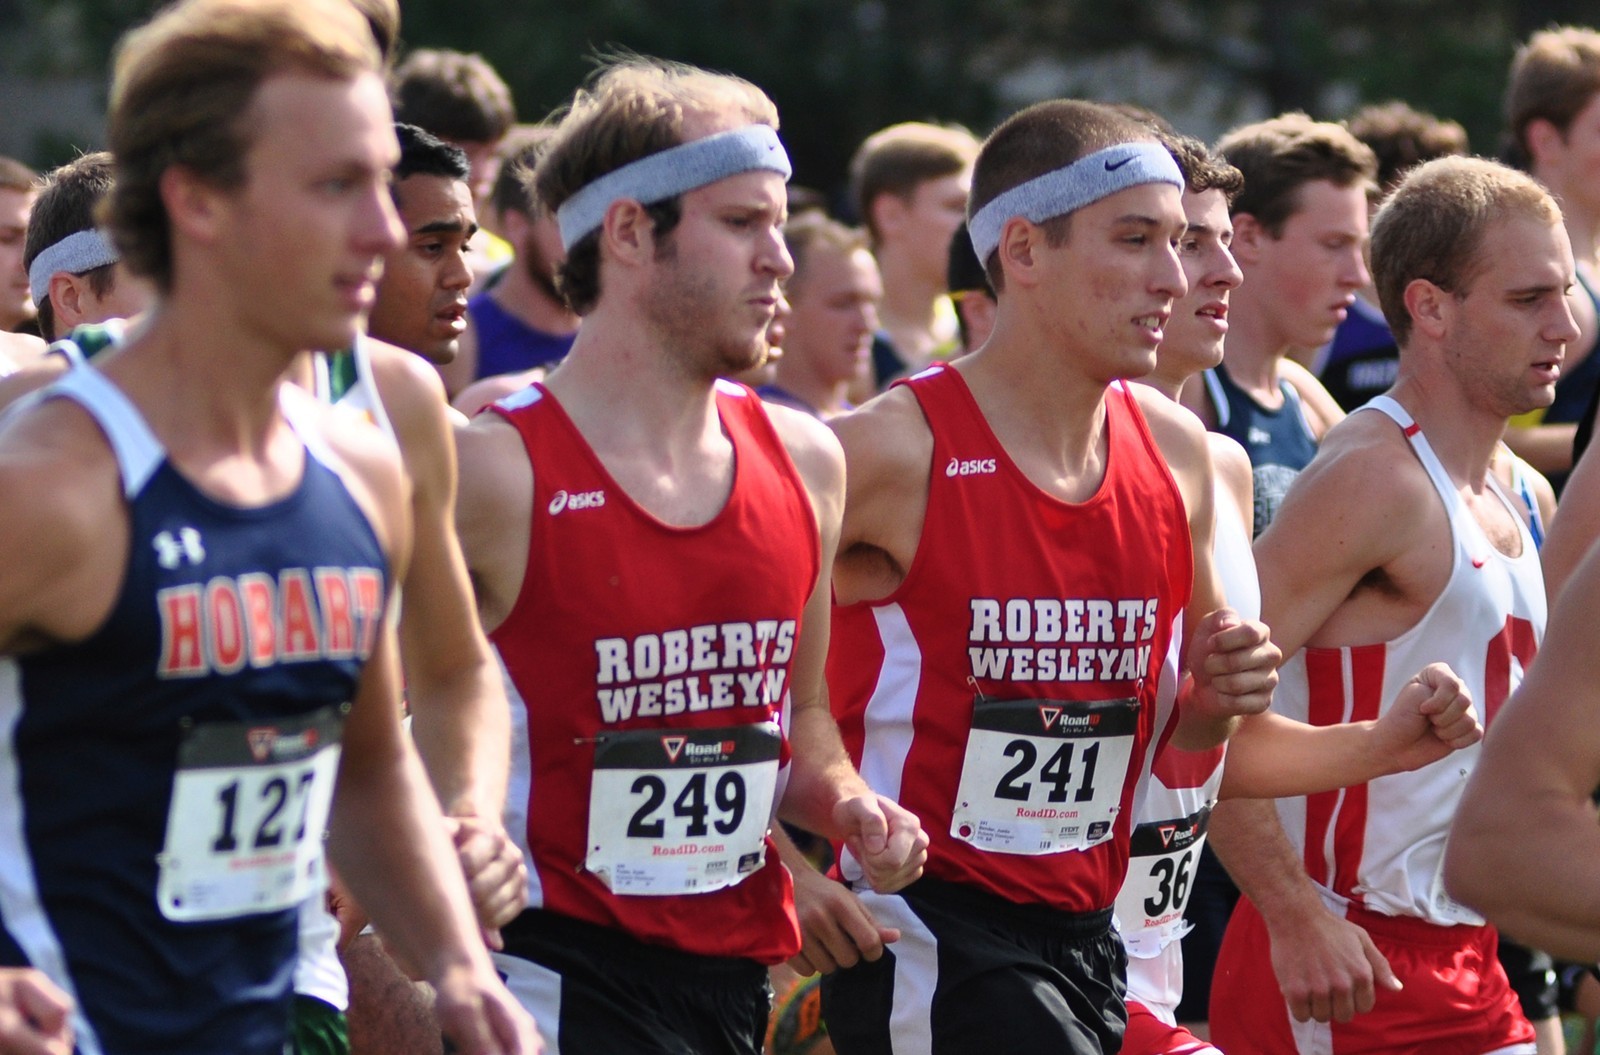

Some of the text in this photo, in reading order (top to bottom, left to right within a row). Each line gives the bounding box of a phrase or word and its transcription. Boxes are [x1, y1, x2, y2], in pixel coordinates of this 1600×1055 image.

[959, 458, 997, 476] asics
[566, 490, 606, 511] asics
[157, 566, 384, 680] HOBART
[969, 598, 1158, 643] ROBERTS
[595, 619, 796, 685] ROBERTS
[968, 645, 1152, 681] WESLEYAN
[596, 668, 787, 724] WESLEYN
[1059, 713, 1101, 727] RoadID
[685, 740, 736, 757] RoadID
[993, 738, 1101, 803] 241
[213, 771, 316, 855] 127
[626, 771, 747, 839] 249
[1016, 806, 1079, 820] RoadID.com
[652, 843, 726, 858] RoadID.com
[1143, 850, 1193, 918] 36
